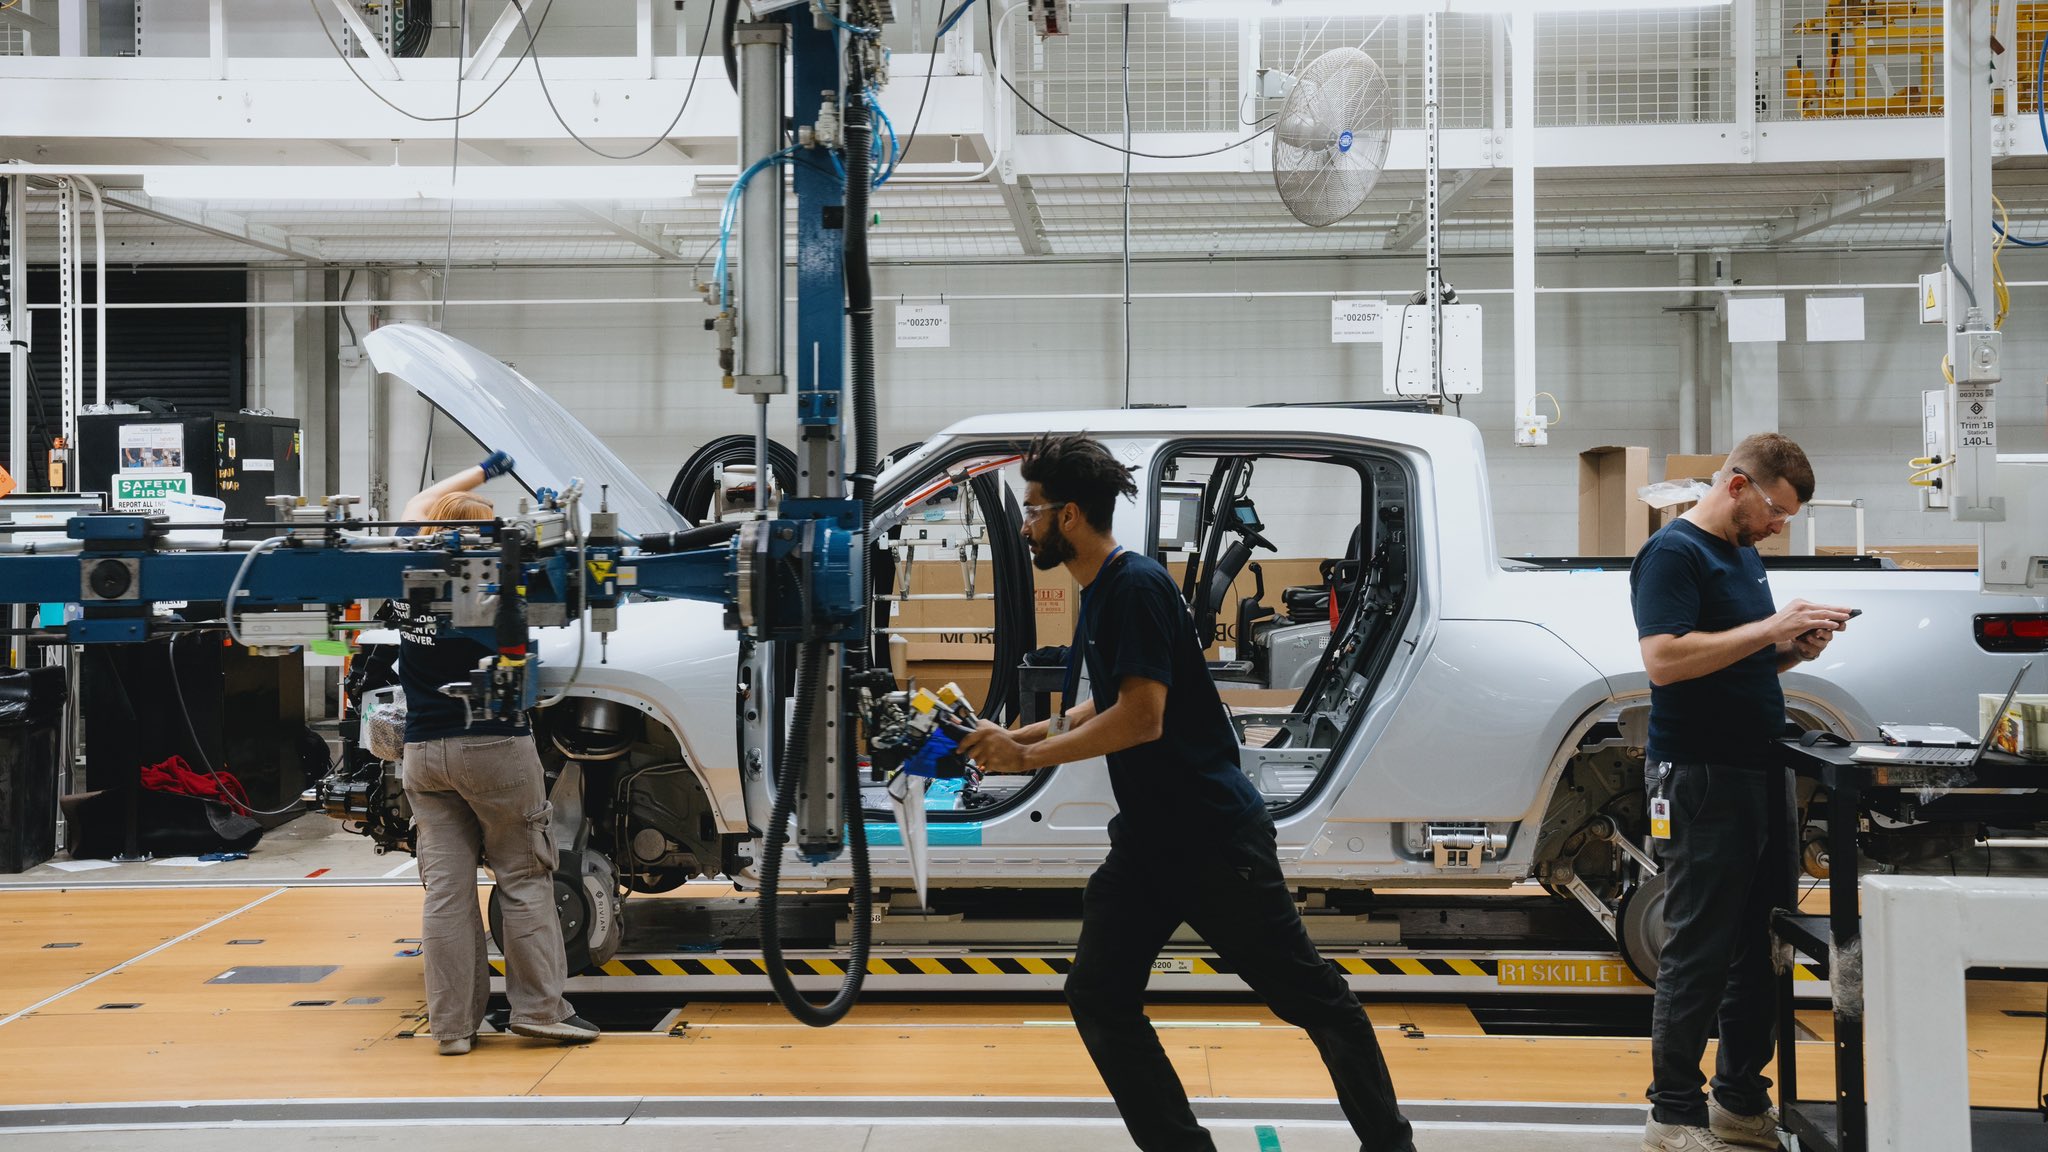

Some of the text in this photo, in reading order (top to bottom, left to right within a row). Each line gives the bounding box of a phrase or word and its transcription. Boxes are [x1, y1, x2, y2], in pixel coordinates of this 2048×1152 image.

[1960, 421, 1994, 429] Trim 1B
[1963, 437, 1993, 446] 140-L
[122, 480, 183, 493] SAFETY
[598, 901, 606, 931] RIVIAN
[1152, 961, 1172, 969] 3200
[1532, 964, 1626, 982] SKILLET
